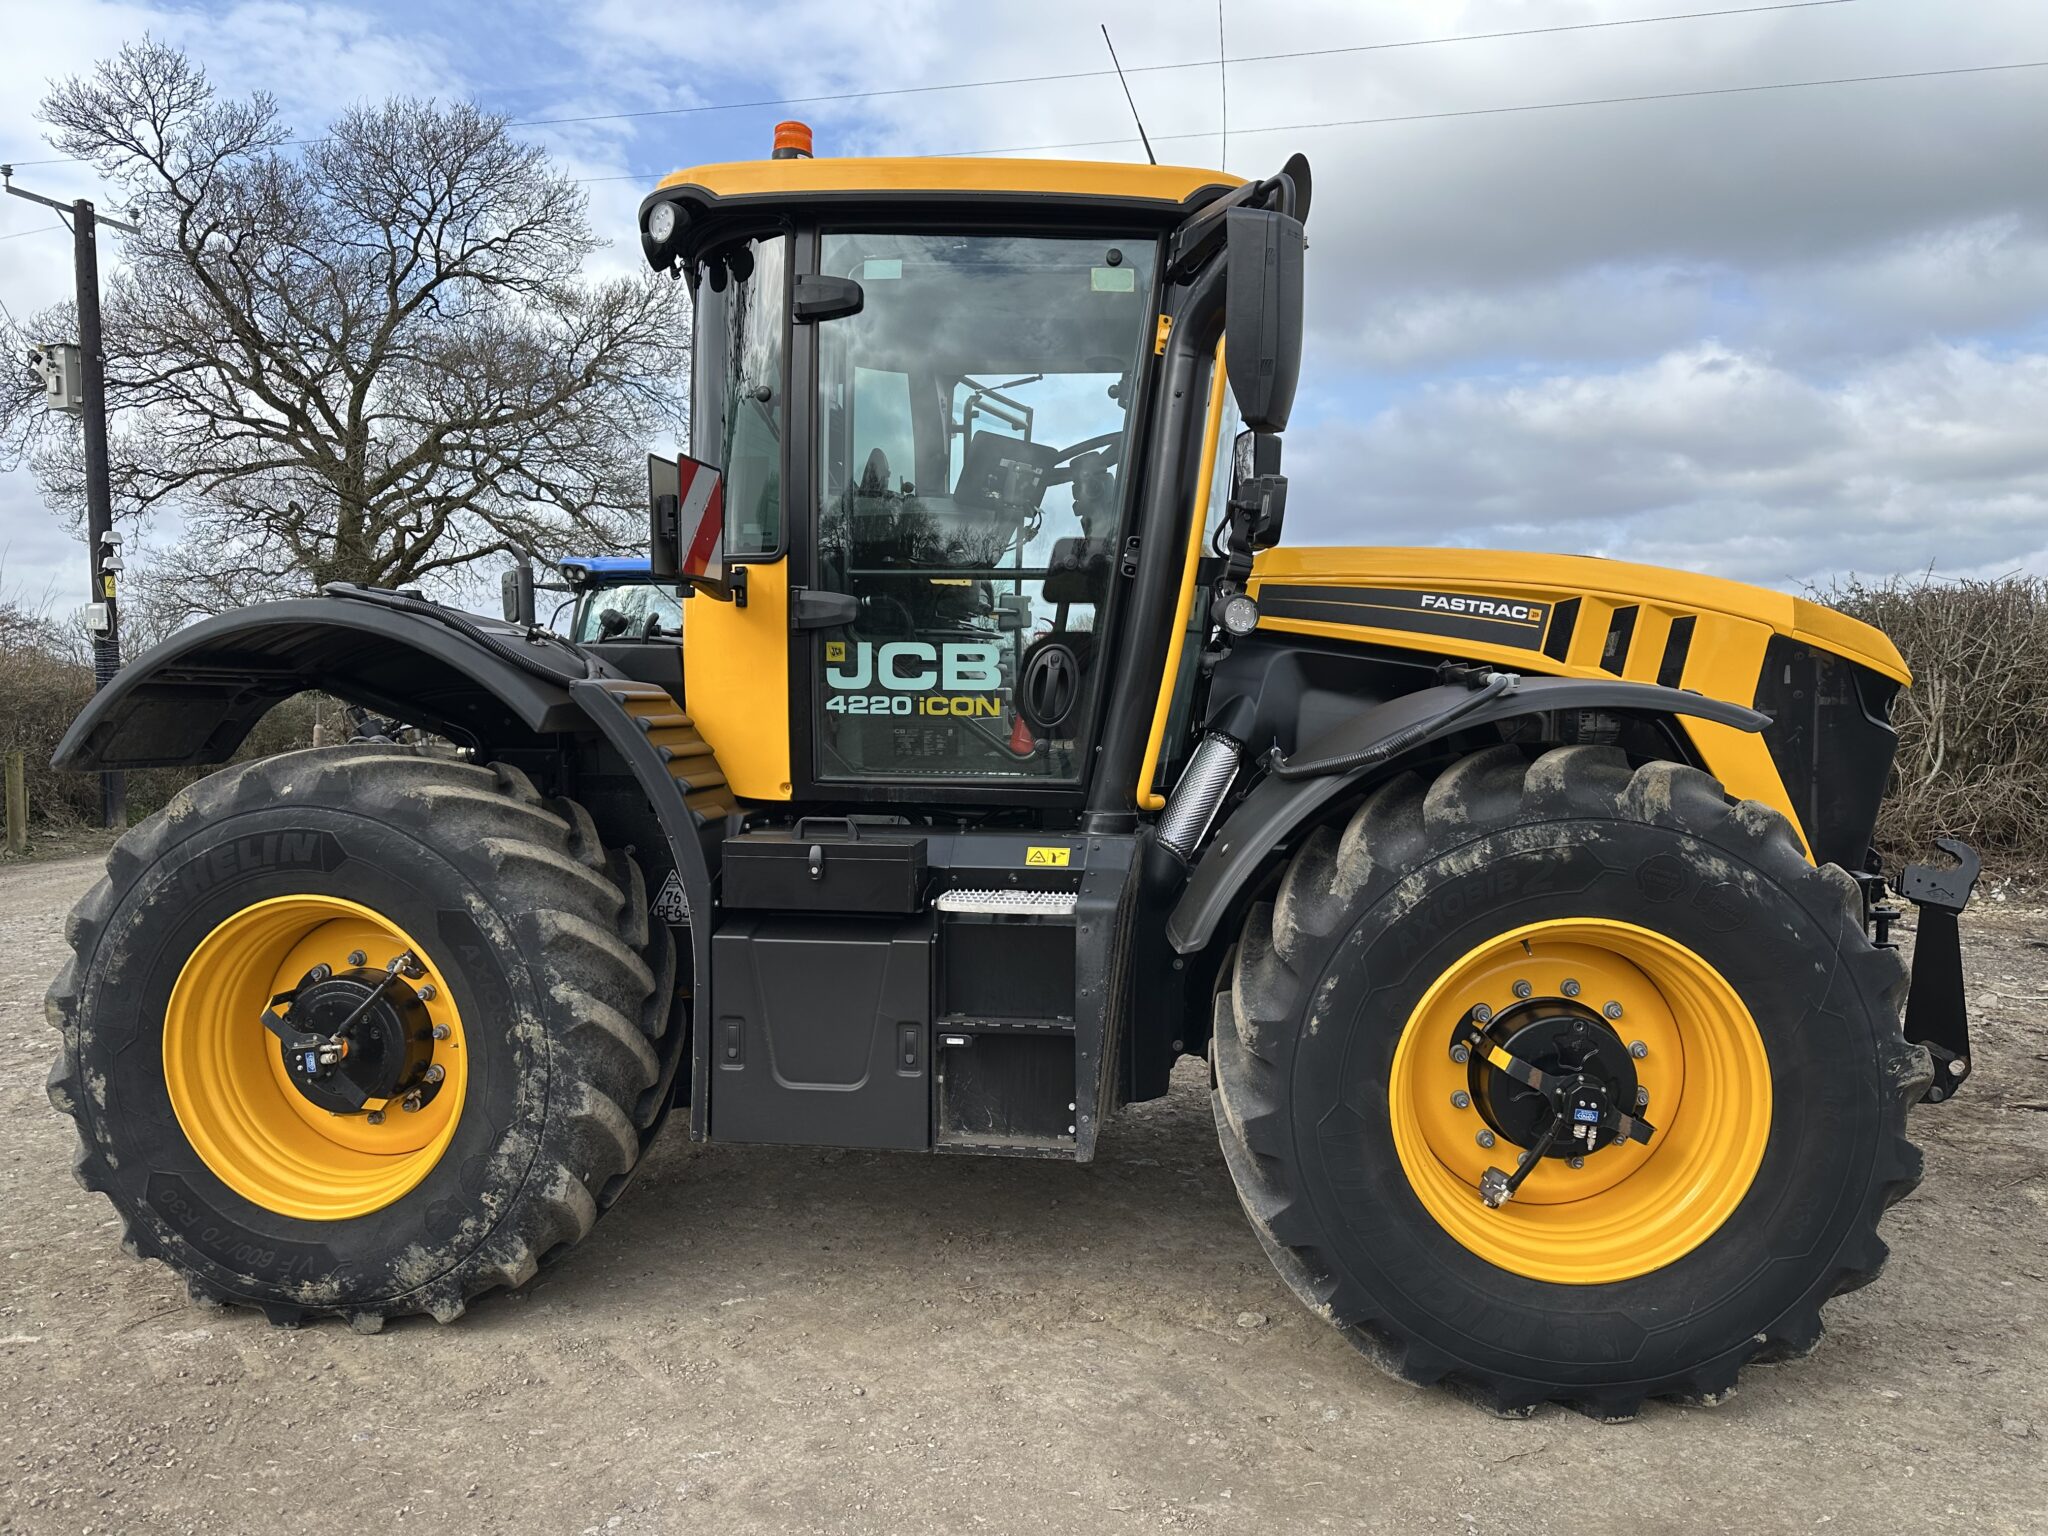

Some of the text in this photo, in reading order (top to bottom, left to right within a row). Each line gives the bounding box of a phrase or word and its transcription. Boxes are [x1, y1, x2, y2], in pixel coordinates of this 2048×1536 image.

[1421, 595, 1528, 619] FASTRAC
[827, 642, 1001, 690] JCB
[826, 695, 1000, 716] 4220 iCON
[181, 831, 319, 898] HELIN
[666, 891, 682, 904] 76
[158, 1187, 200, 1228] R30
[200, 1222, 275, 1269] 600/70
